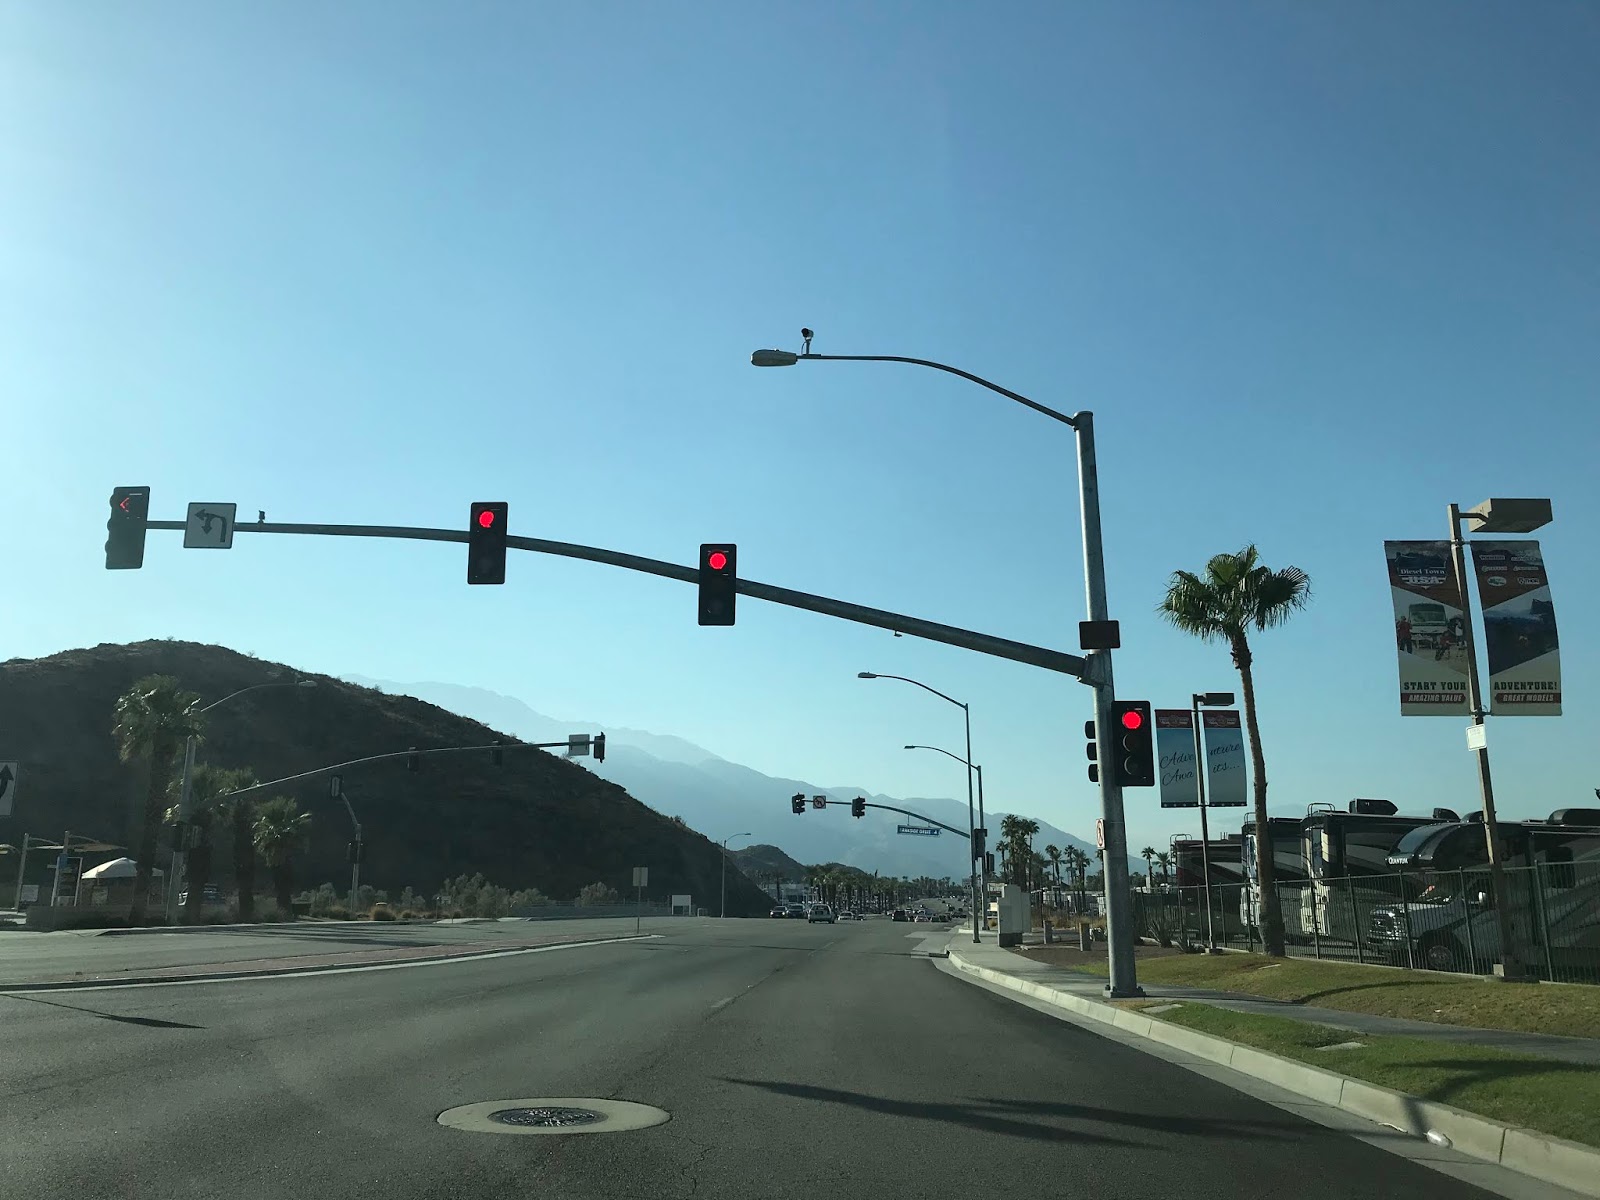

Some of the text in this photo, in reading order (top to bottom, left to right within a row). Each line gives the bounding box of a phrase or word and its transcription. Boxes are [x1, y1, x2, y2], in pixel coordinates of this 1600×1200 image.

[1408, 576, 1440, 585] USA
[1404, 681, 1467, 691] START YOUR
[1494, 681, 1558, 690] ADVENTURE!
[1408, 694, 1463, 702] AMAZING VALUE
[1503, 694, 1554, 702] GREAT MODELS
[1388, 857, 1408, 865] QUANTUM
